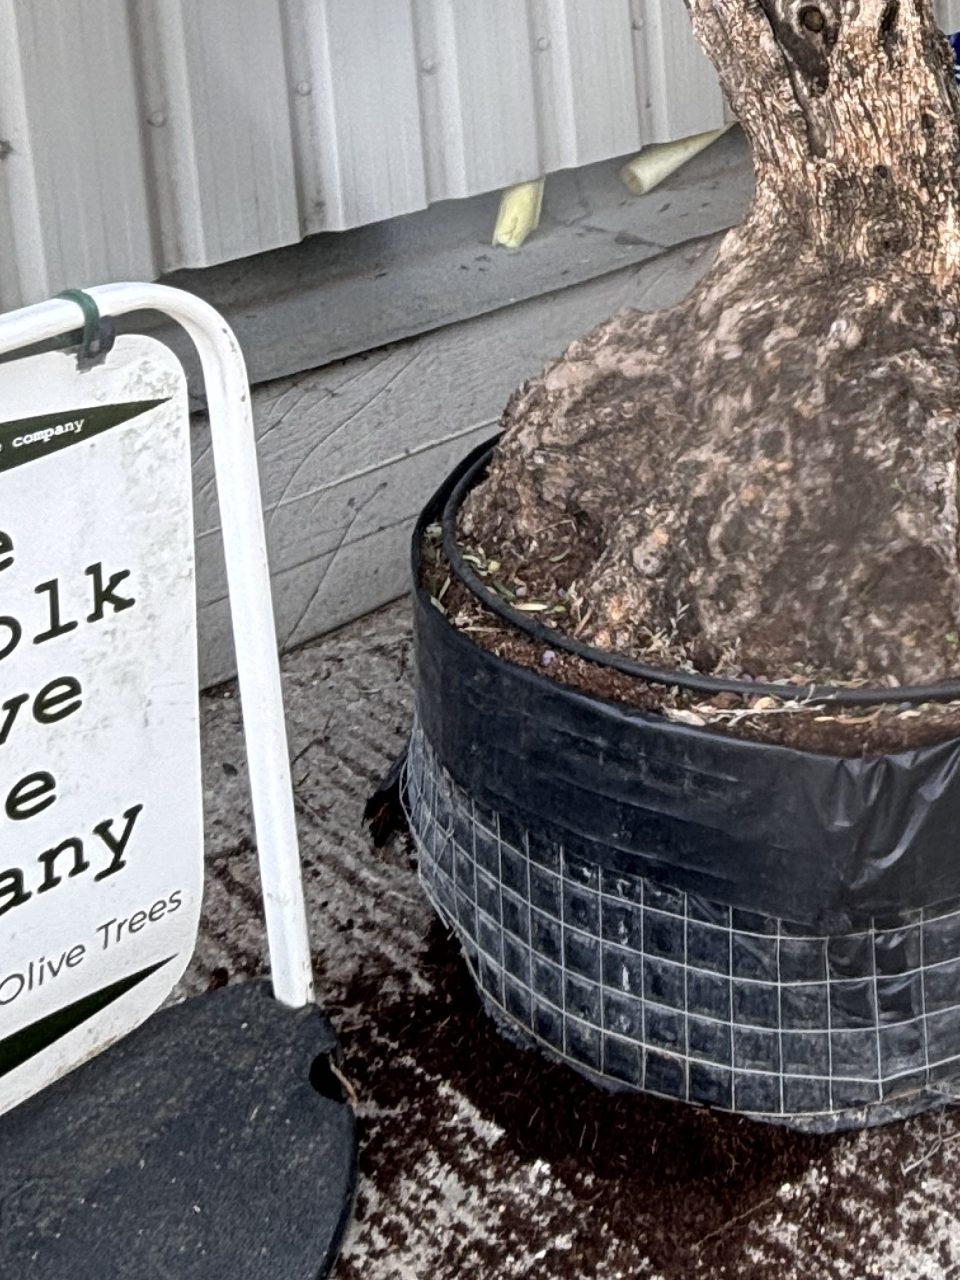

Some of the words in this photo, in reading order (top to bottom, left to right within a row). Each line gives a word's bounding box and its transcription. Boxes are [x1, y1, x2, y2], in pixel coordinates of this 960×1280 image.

[12, 419, 85, 448] company
[5, 771, 56, 821] e
[0, 804, 143, 916] any
[0, 944, 86, 1006] Olive
[96, 890, 182, 950] Trees
